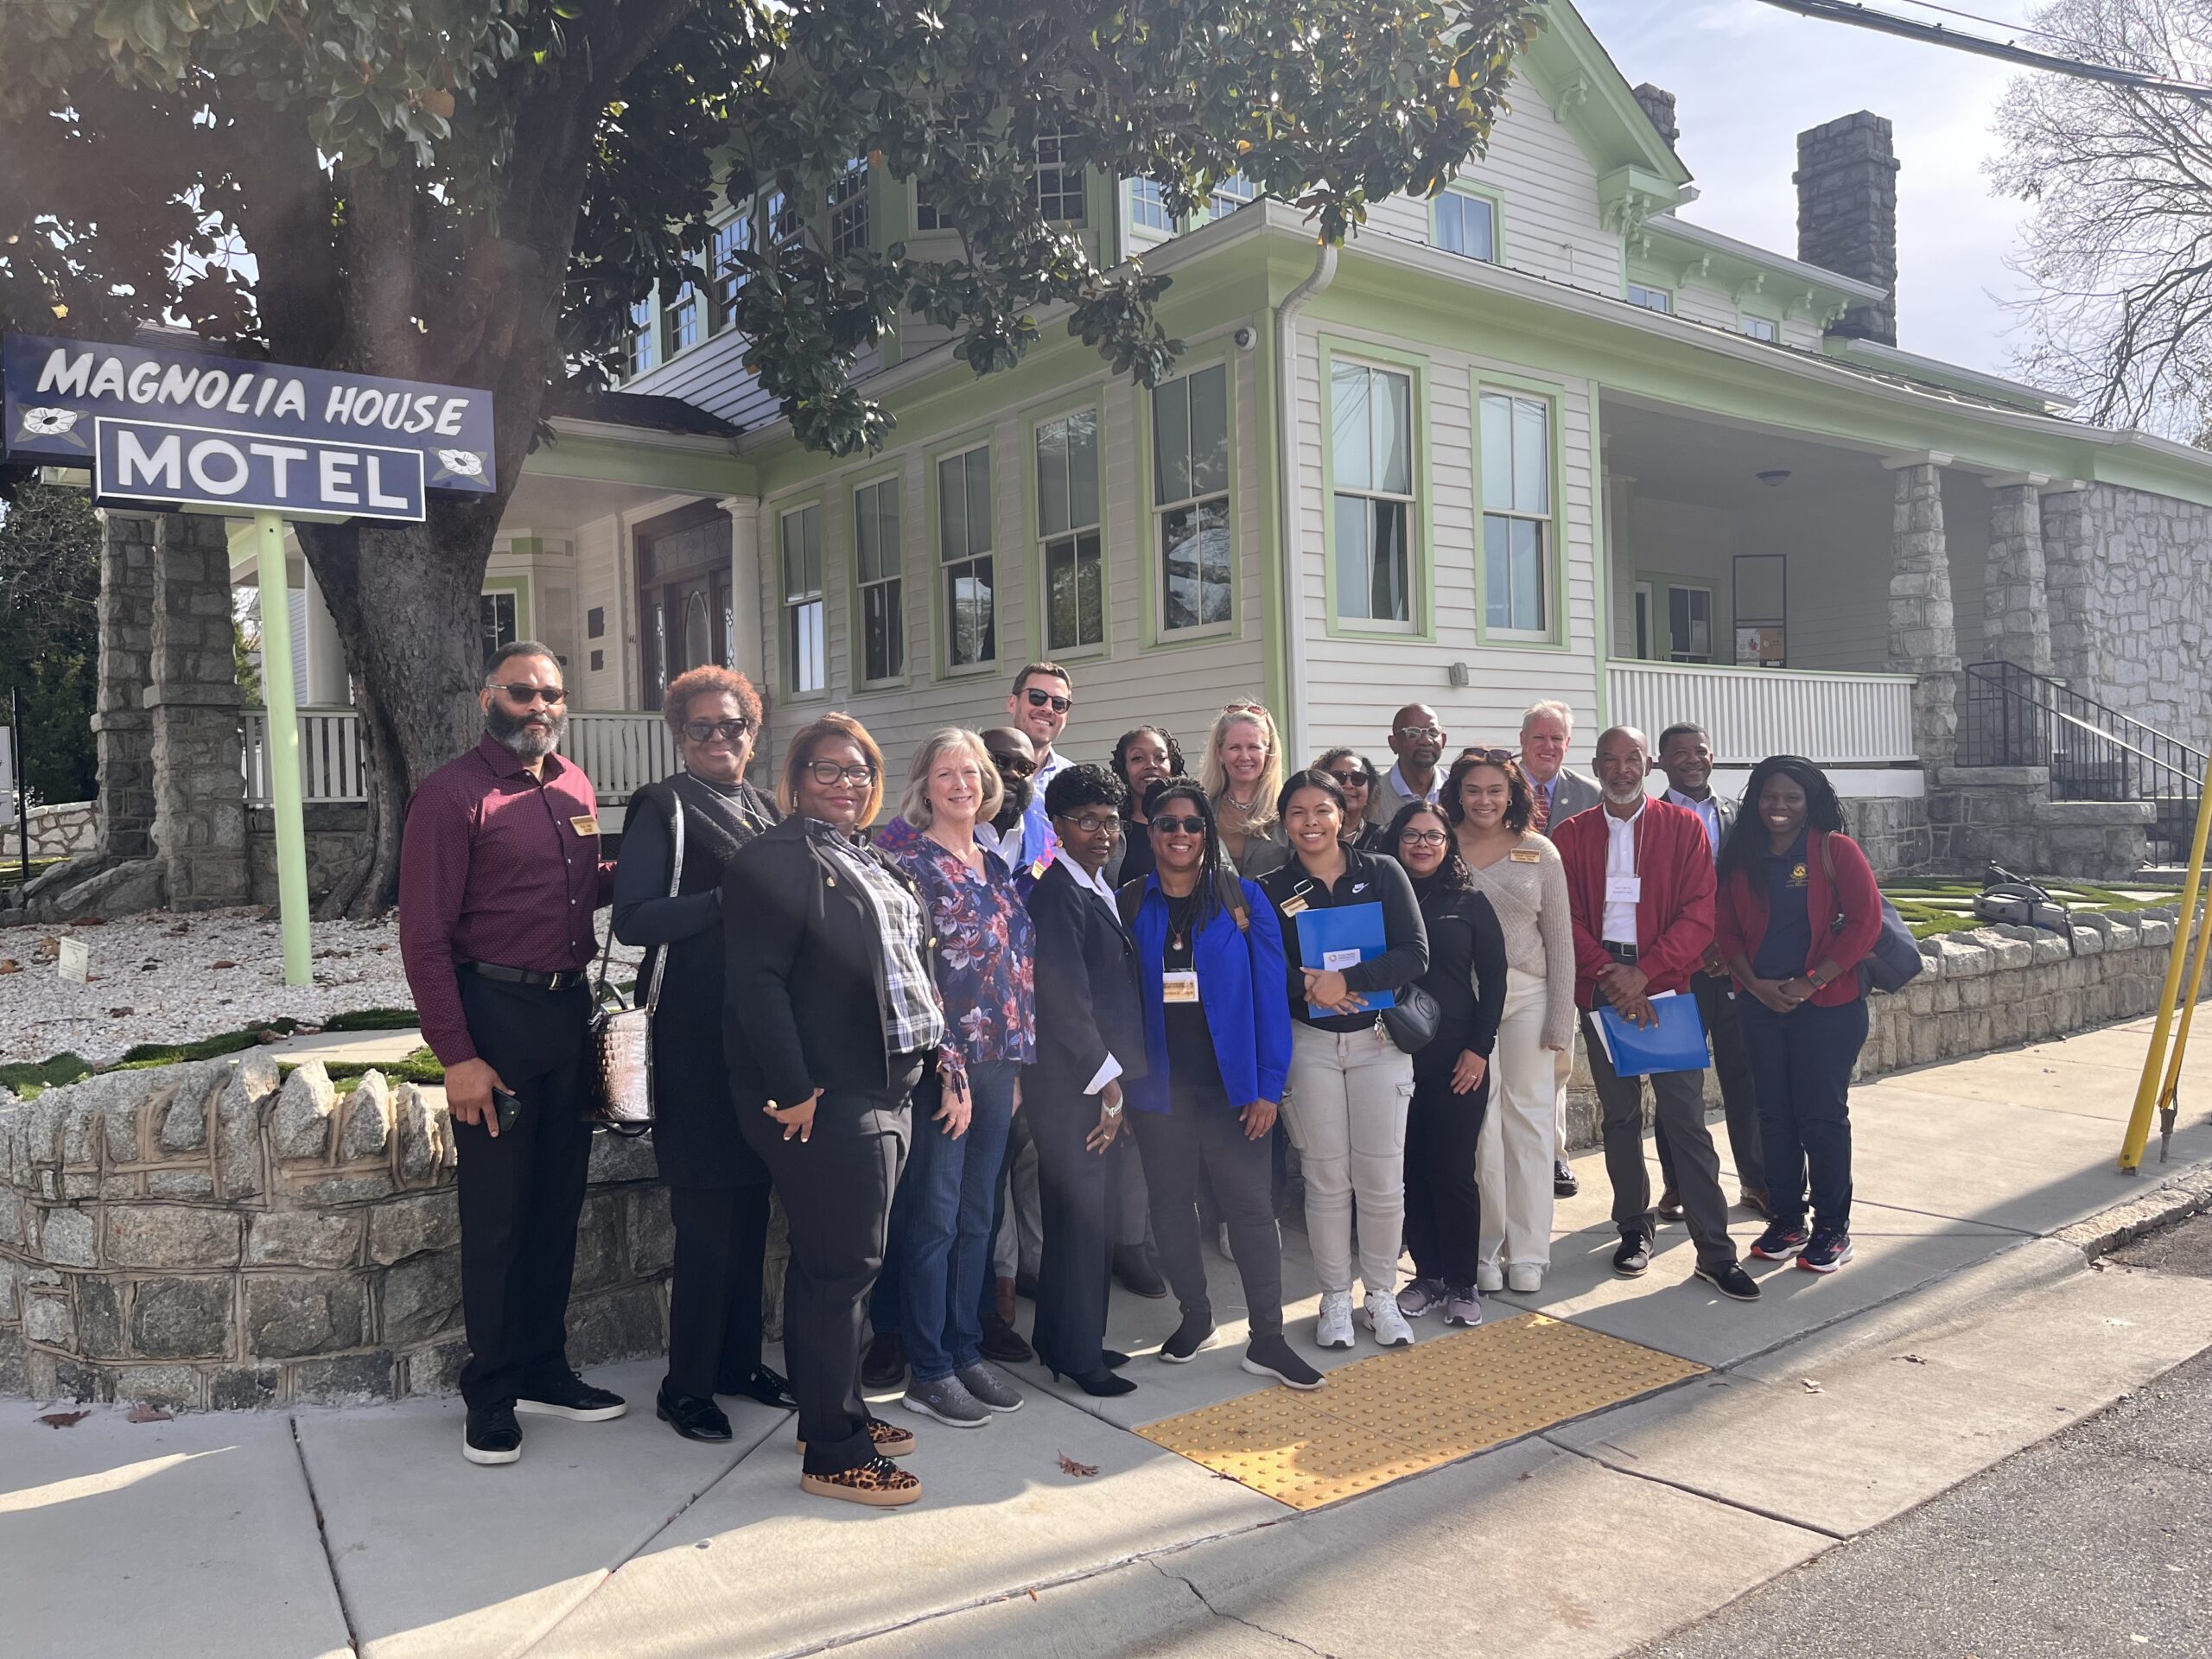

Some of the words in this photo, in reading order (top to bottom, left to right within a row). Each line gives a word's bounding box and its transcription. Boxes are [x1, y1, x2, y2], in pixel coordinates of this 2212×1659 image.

[36, 348, 306, 422] MAGNOLIA
[324, 385, 470, 436] HOUSE
[118, 429, 409, 510] MOTEL
